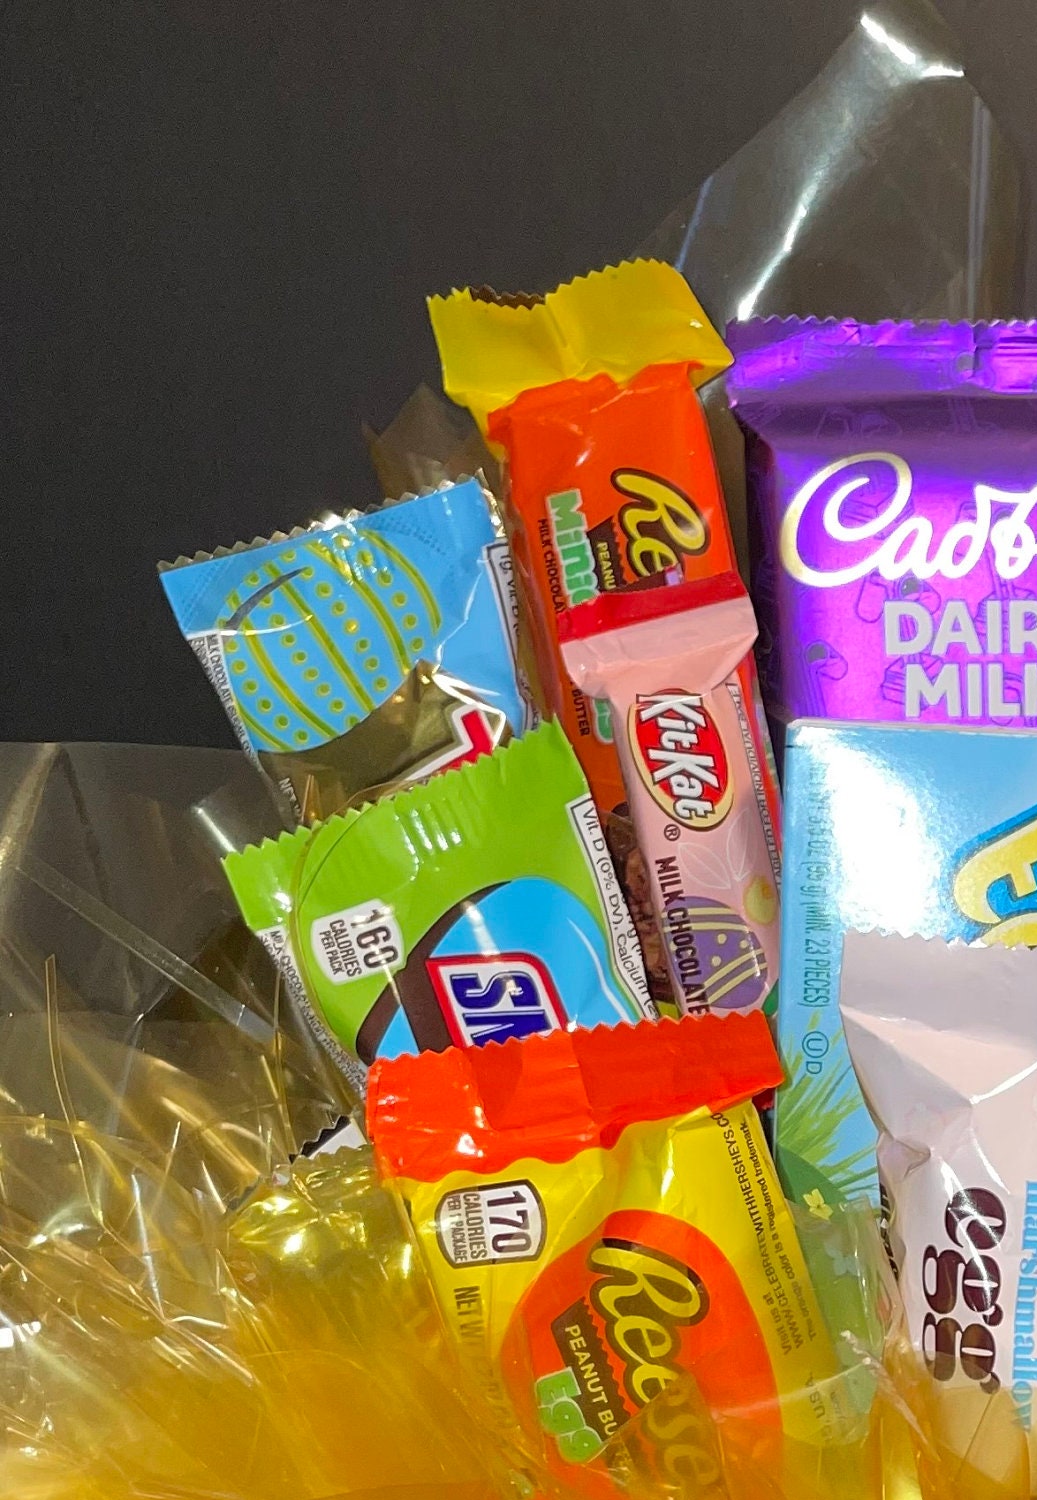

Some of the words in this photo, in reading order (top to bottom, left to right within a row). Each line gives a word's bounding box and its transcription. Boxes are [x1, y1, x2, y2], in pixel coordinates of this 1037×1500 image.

[596, 541, 617, 590] PEANU
[571, 688, 590, 736] BUTTER
[582, 807, 598, 836] Vit.
[593, 841, 607, 852] D
[595, 856, 617, 890] (0%
[655, 856, 685, 905] MILK
[320, 930, 335, 950] PER
[325, 950, 345, 976] PACK
[330, 919, 363, 978] CALORIES
[350, 909, 398, 968] 160
[616, 933, 650, 993] Calcium
[667, 907, 711, 1016] CHOCOLATE
[804, 938, 831, 955] 23
[799, 958, 832, 1008] PIECES)
[447, 1195, 462, 1211] PER
[463, 1193, 487, 1259] CALORIES
[486, 1190, 532, 1254] 170
[449, 1221, 468, 1262] PACKAGE
[710, 1112, 804, 1350] WWW.CELEBRATEWITHHERSHEYS.CO
[776, 1253, 795, 1280] color
[922, 1187, 1007, 1394] egg
[454, 1286, 482, 1316] NET
[564, 1323, 609, 1405] PEANUT
[535, 1366, 604, 1464] Egg
